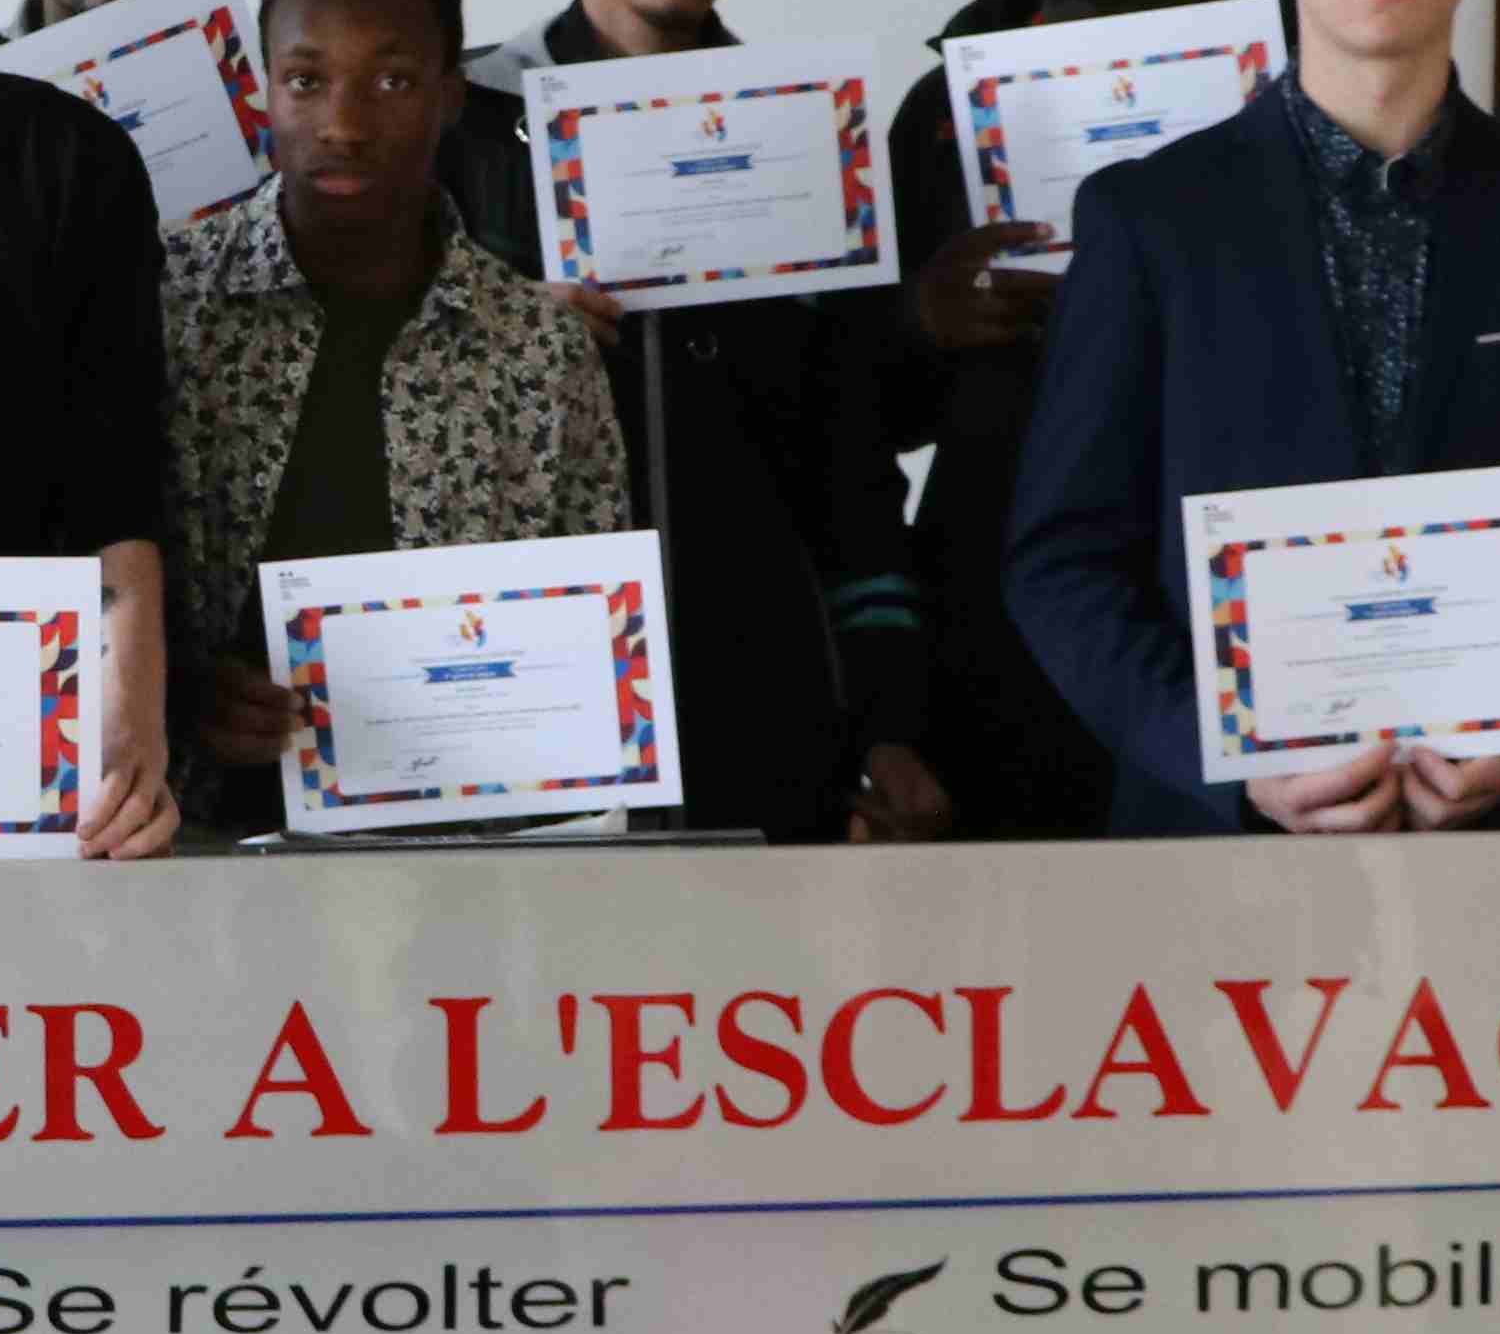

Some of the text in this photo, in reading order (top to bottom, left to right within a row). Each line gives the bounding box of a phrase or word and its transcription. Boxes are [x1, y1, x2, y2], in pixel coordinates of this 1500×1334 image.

[222, 999, 374, 1141] A
[167, 1262, 631, 1334] révolter
[991, 1247, 1147, 1317] Se
